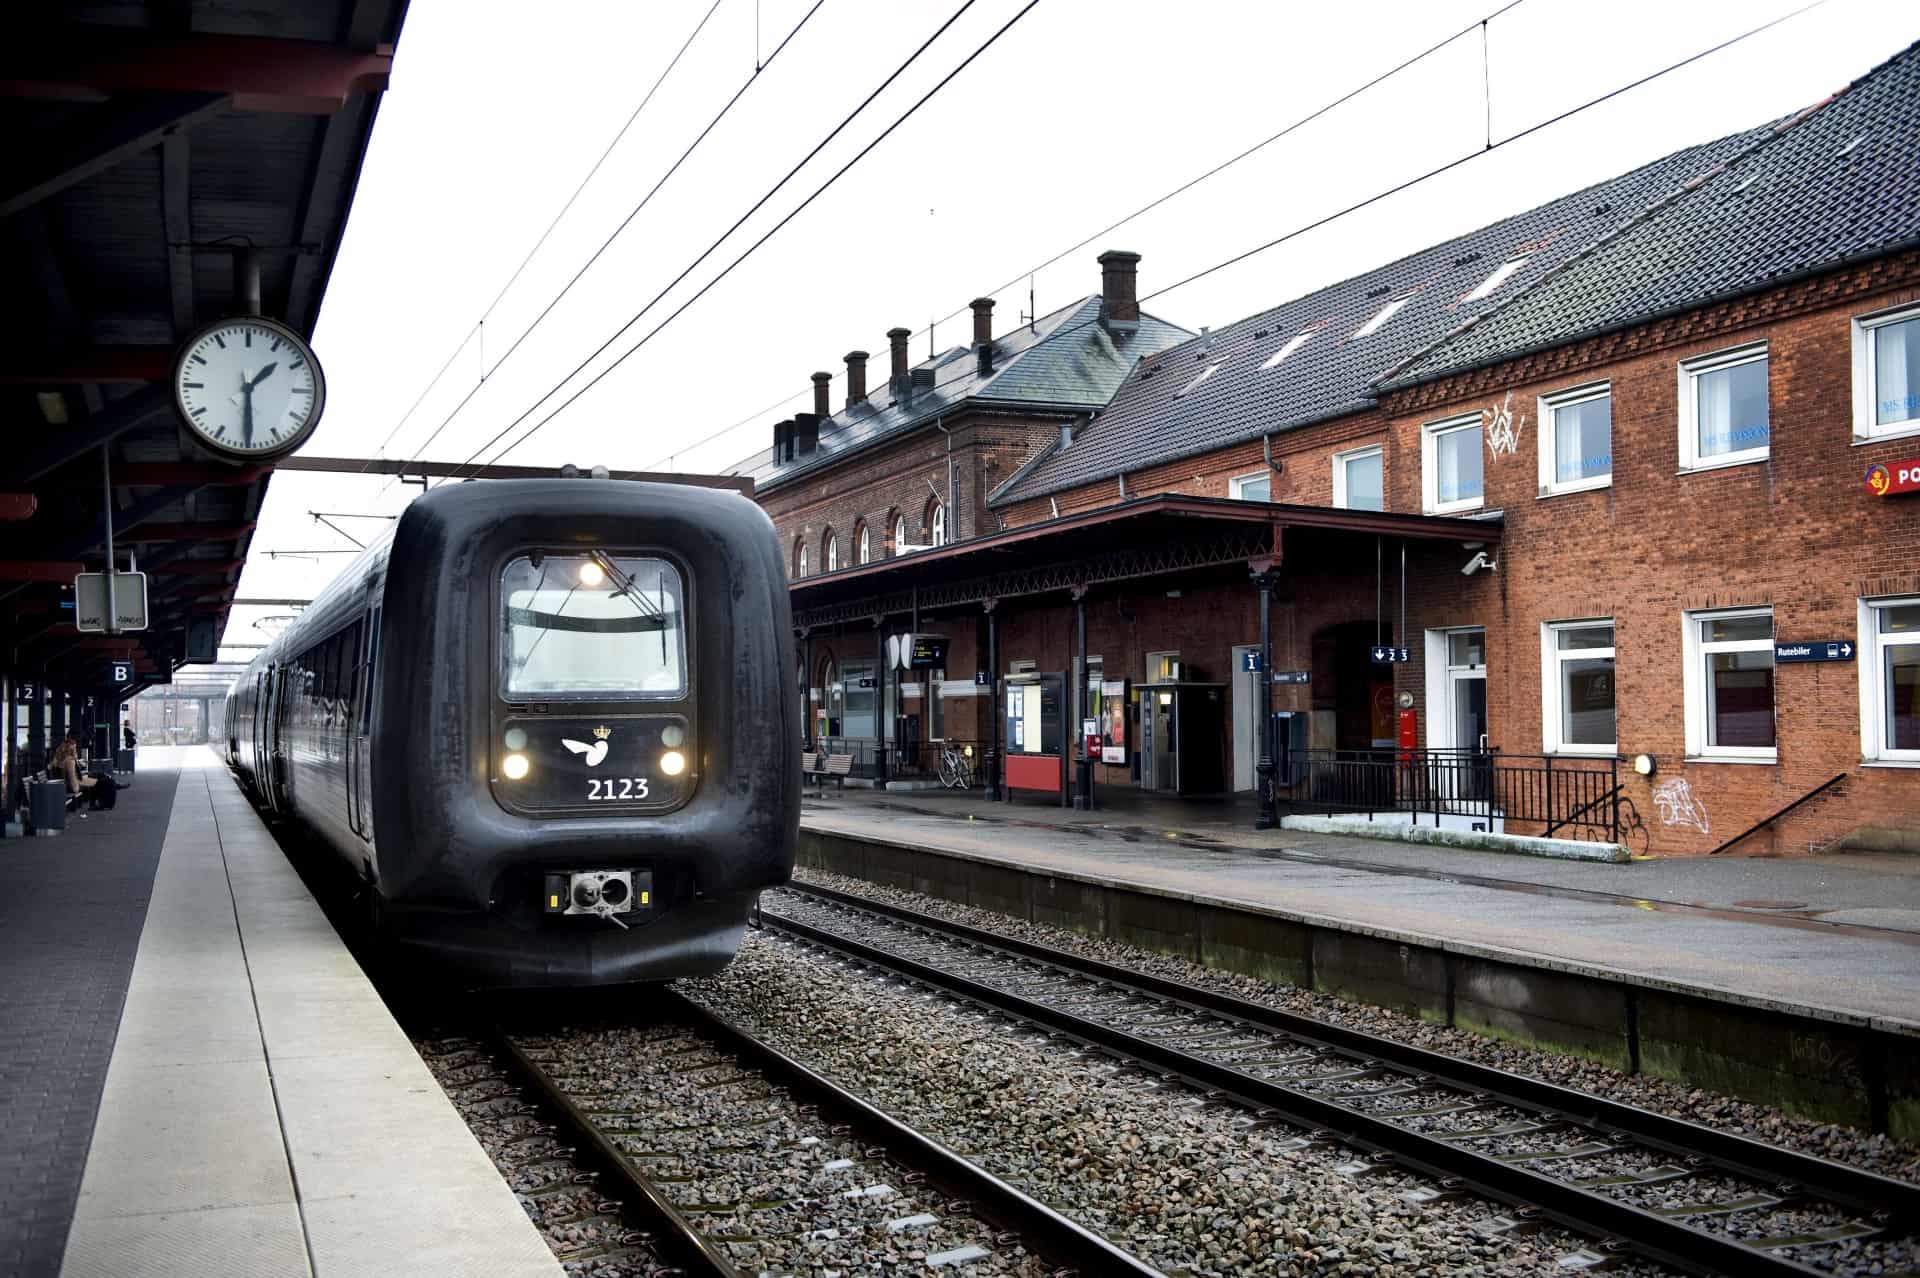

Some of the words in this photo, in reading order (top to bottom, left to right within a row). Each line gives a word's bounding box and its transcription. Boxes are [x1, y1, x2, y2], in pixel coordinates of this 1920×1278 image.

[1389, 652, 1396, 661] 2
[1401, 652, 1408, 661] 3
[1777, 647, 1811, 656] Rutebiler
[1249, 658, 1256, 670] 1
[115, 666, 127, 681] B
[24, 687, 33, 699] 2
[87, 698, 94, 707] 2
[587, 778, 649, 801] 2123
